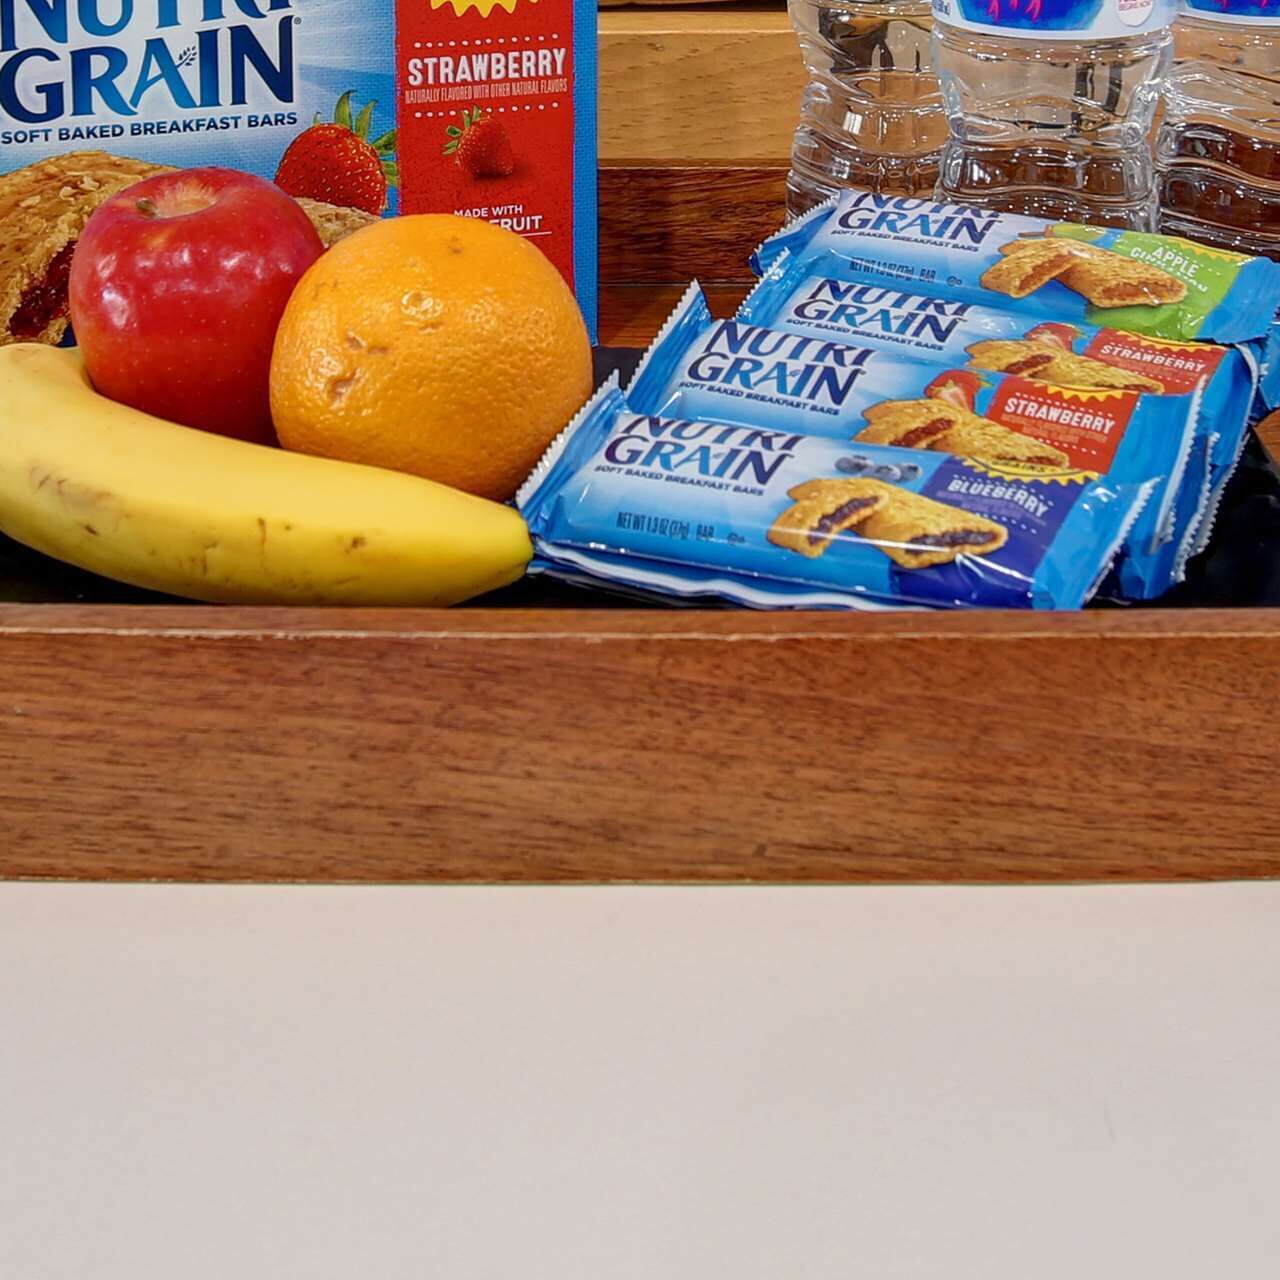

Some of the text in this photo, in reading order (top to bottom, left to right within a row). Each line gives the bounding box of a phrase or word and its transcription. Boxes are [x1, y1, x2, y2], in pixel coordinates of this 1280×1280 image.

[407, 47, 566, 87] STRAWBERRY
[405, 78, 568, 104] NATURALLY FLAVORED WITH OTHER NATURAL FLAVORS
[0, 111, 298, 145] SOFT BAKED BREAKFAST BARS
[491, 204, 523, 216] WITH
[838, 207, 1001, 245] GRAIN
[830, 229, 980, 253] SOFT BAKED BREAKFAST BARS
[1151, 246, 1200, 278] APPLE
[808, 278, 974, 317] NUTRI
[786, 318, 944, 351] SOFT BAKED BREAKFAST BARS
[793, 298, 966, 343] GRAIN
[703, 320, 877, 368] NUTRI
[1100, 344, 1206, 373] STRAWBERRY
[687, 351, 862, 407] GRAIN
[678, 380, 841, 417] SOFT BAKED BREAKFAST BARS
[1004, 397, 1116, 435] STRAWBERRY
[620, 415, 807, 453] NUTRI
[604, 434, 792, 486] GRAIN
[593, 464, 765, 497] SOFT BAKED BREAKFAST BARS
[947, 478, 1049, 518] BLUEBERRY
[616, 511, 631, 528] NET
[632, 513, 646, 531] WT
